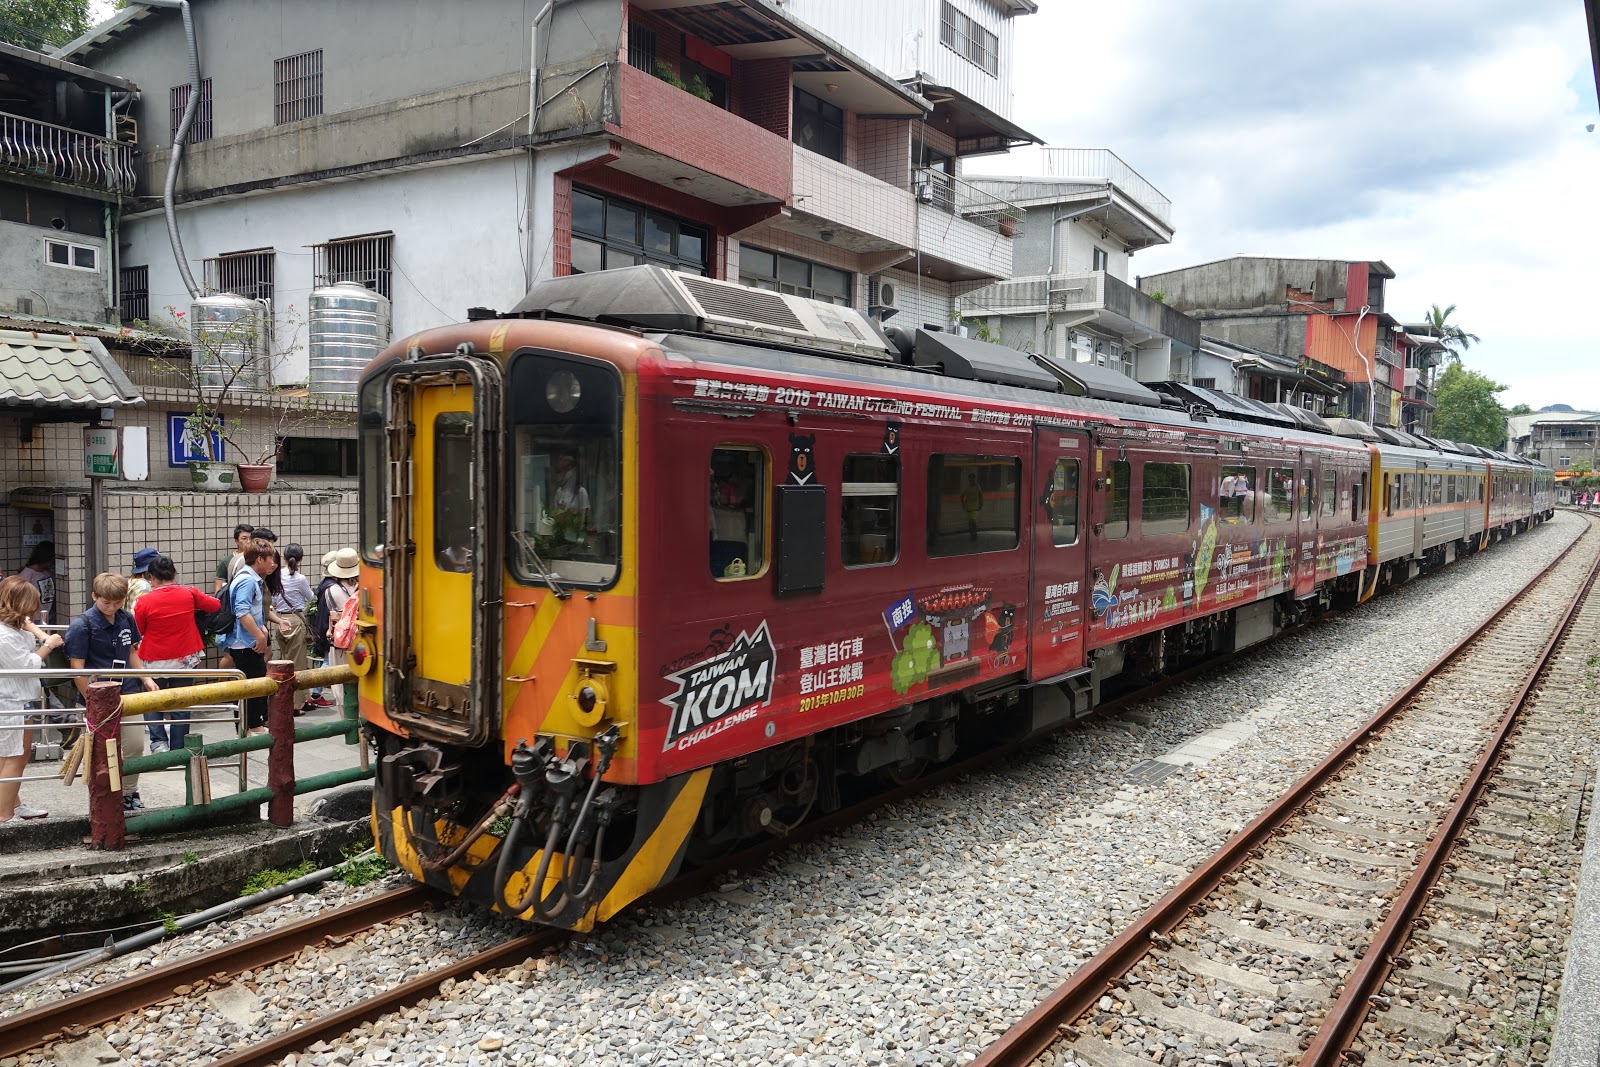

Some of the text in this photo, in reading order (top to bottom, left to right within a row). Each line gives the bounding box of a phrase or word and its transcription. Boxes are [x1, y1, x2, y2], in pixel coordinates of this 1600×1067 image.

[693, 378, 962, 420] 臺灣自行車節 2015 TAIWAN CYCLING FESTIVAL
[1012, 412, 1033, 426] 2015
[892, 599, 913, 628] 南投
[800, 637, 864, 669] 臺灣自行車
[690, 653, 748, 688] TAIWAN
[800, 661, 863, 695] 登山王挑戰
[677, 660, 769, 735] KOM
[799, 684, 864, 713] 2015年10月30日
[678, 705, 759, 751] CHALLENGE
